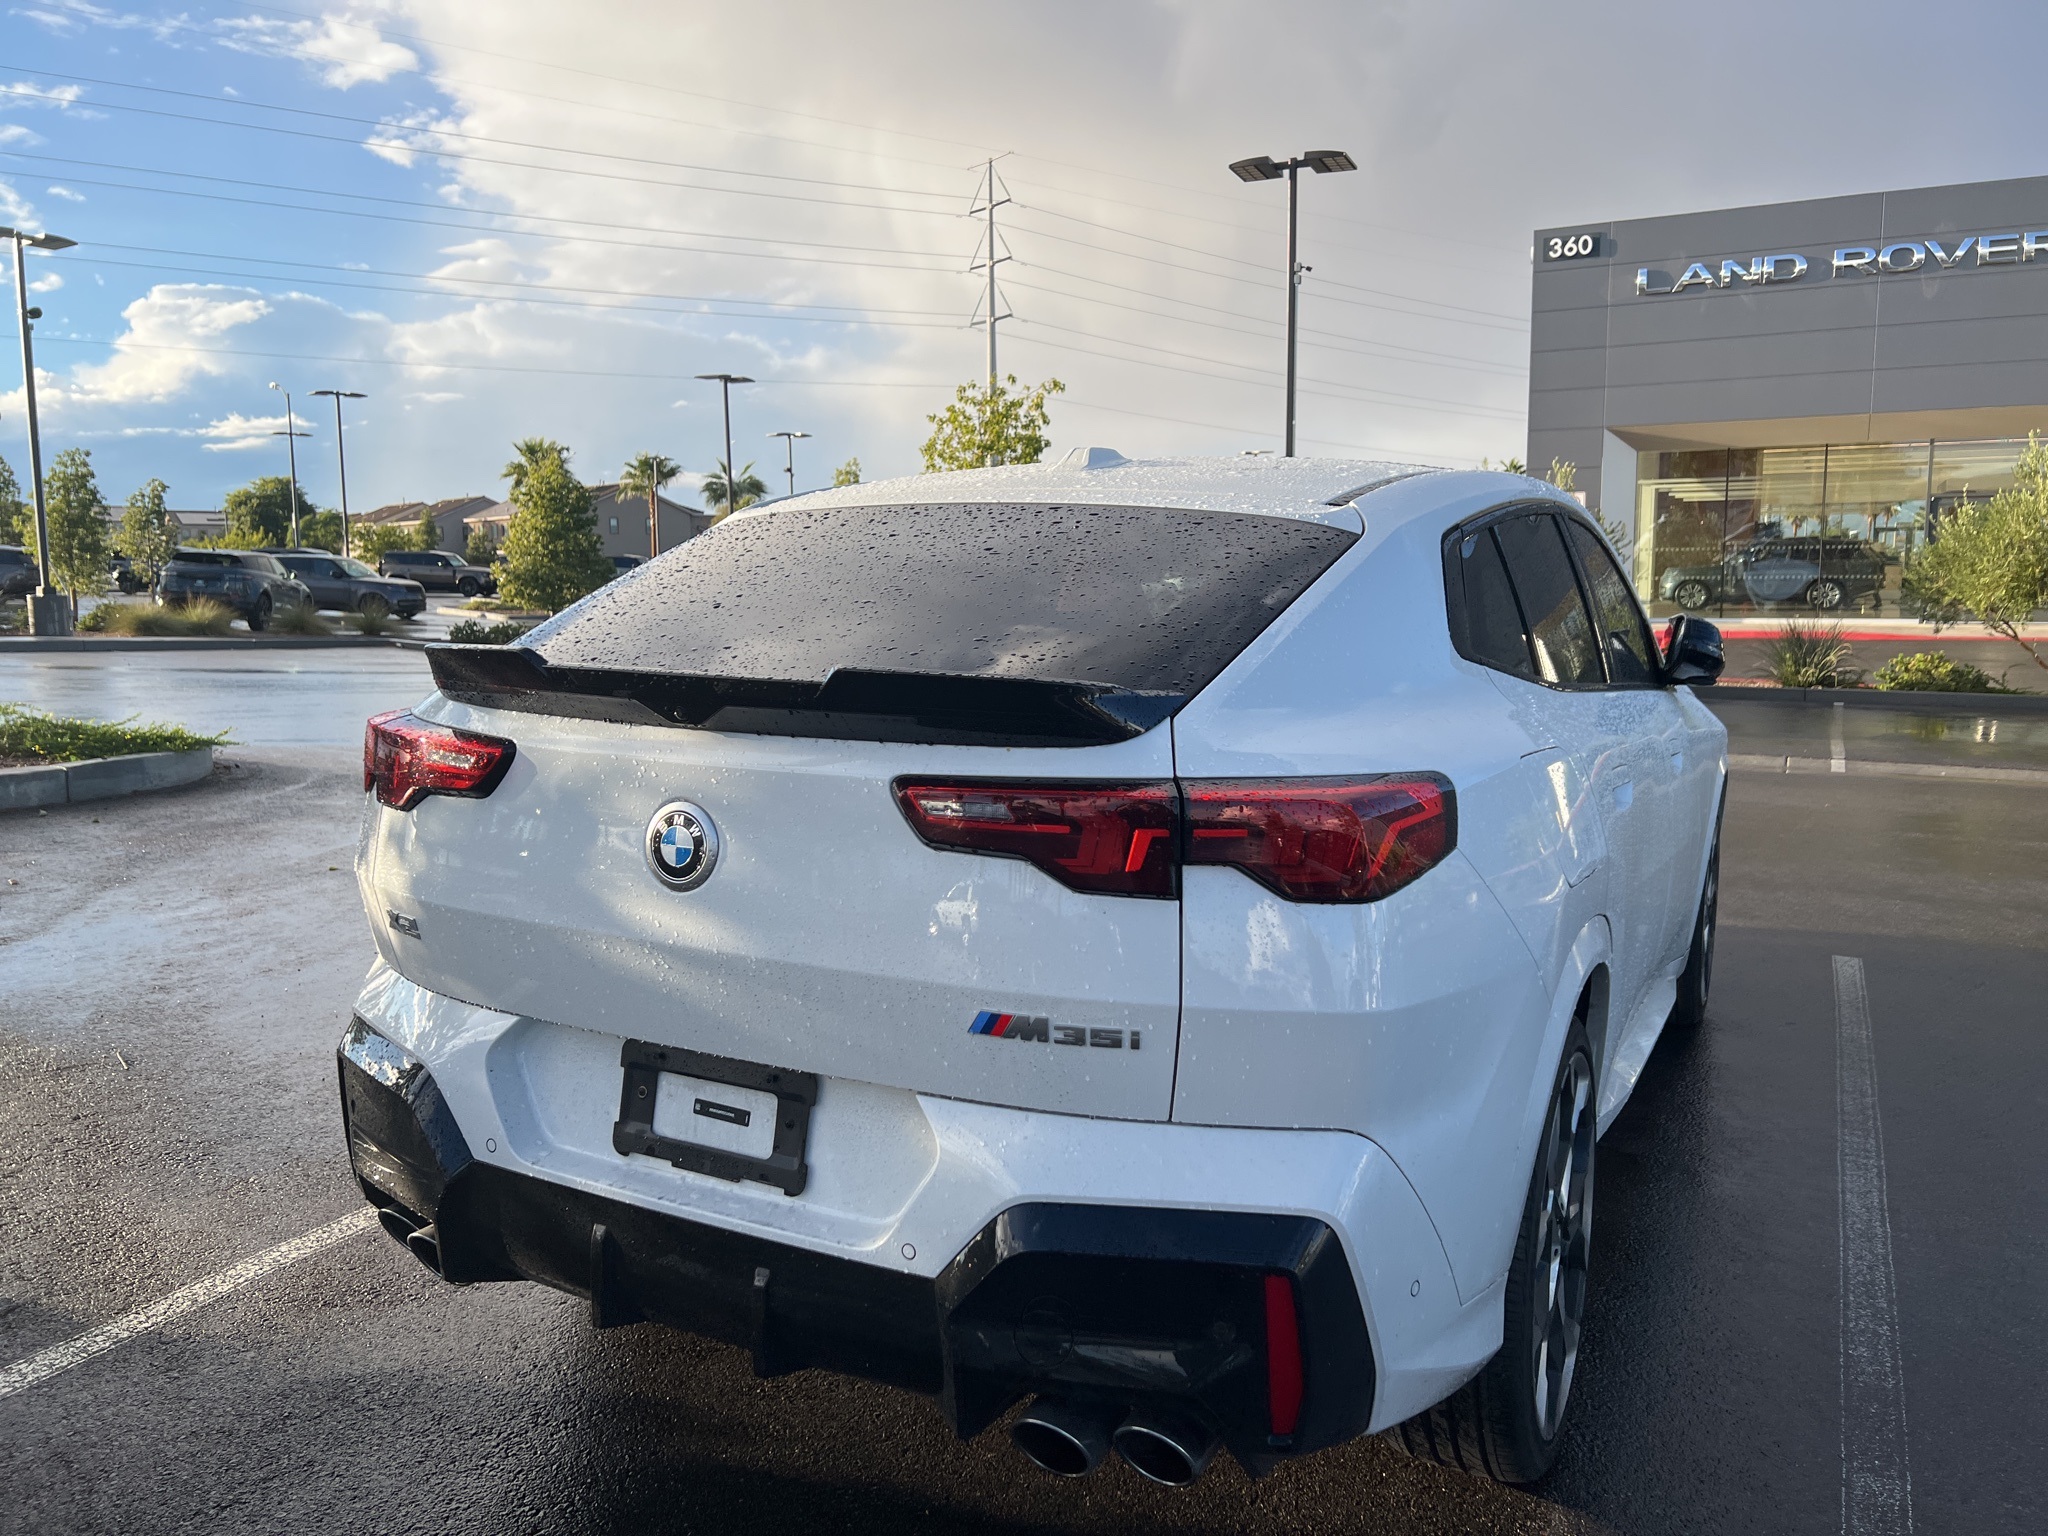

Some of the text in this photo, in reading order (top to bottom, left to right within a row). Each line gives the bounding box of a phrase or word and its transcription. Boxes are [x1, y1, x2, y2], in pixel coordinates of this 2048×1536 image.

[1548, 234, 1593, 258] 360
[1636, 253, 1808, 296] LAND
[657, 814, 702, 838] BMW
